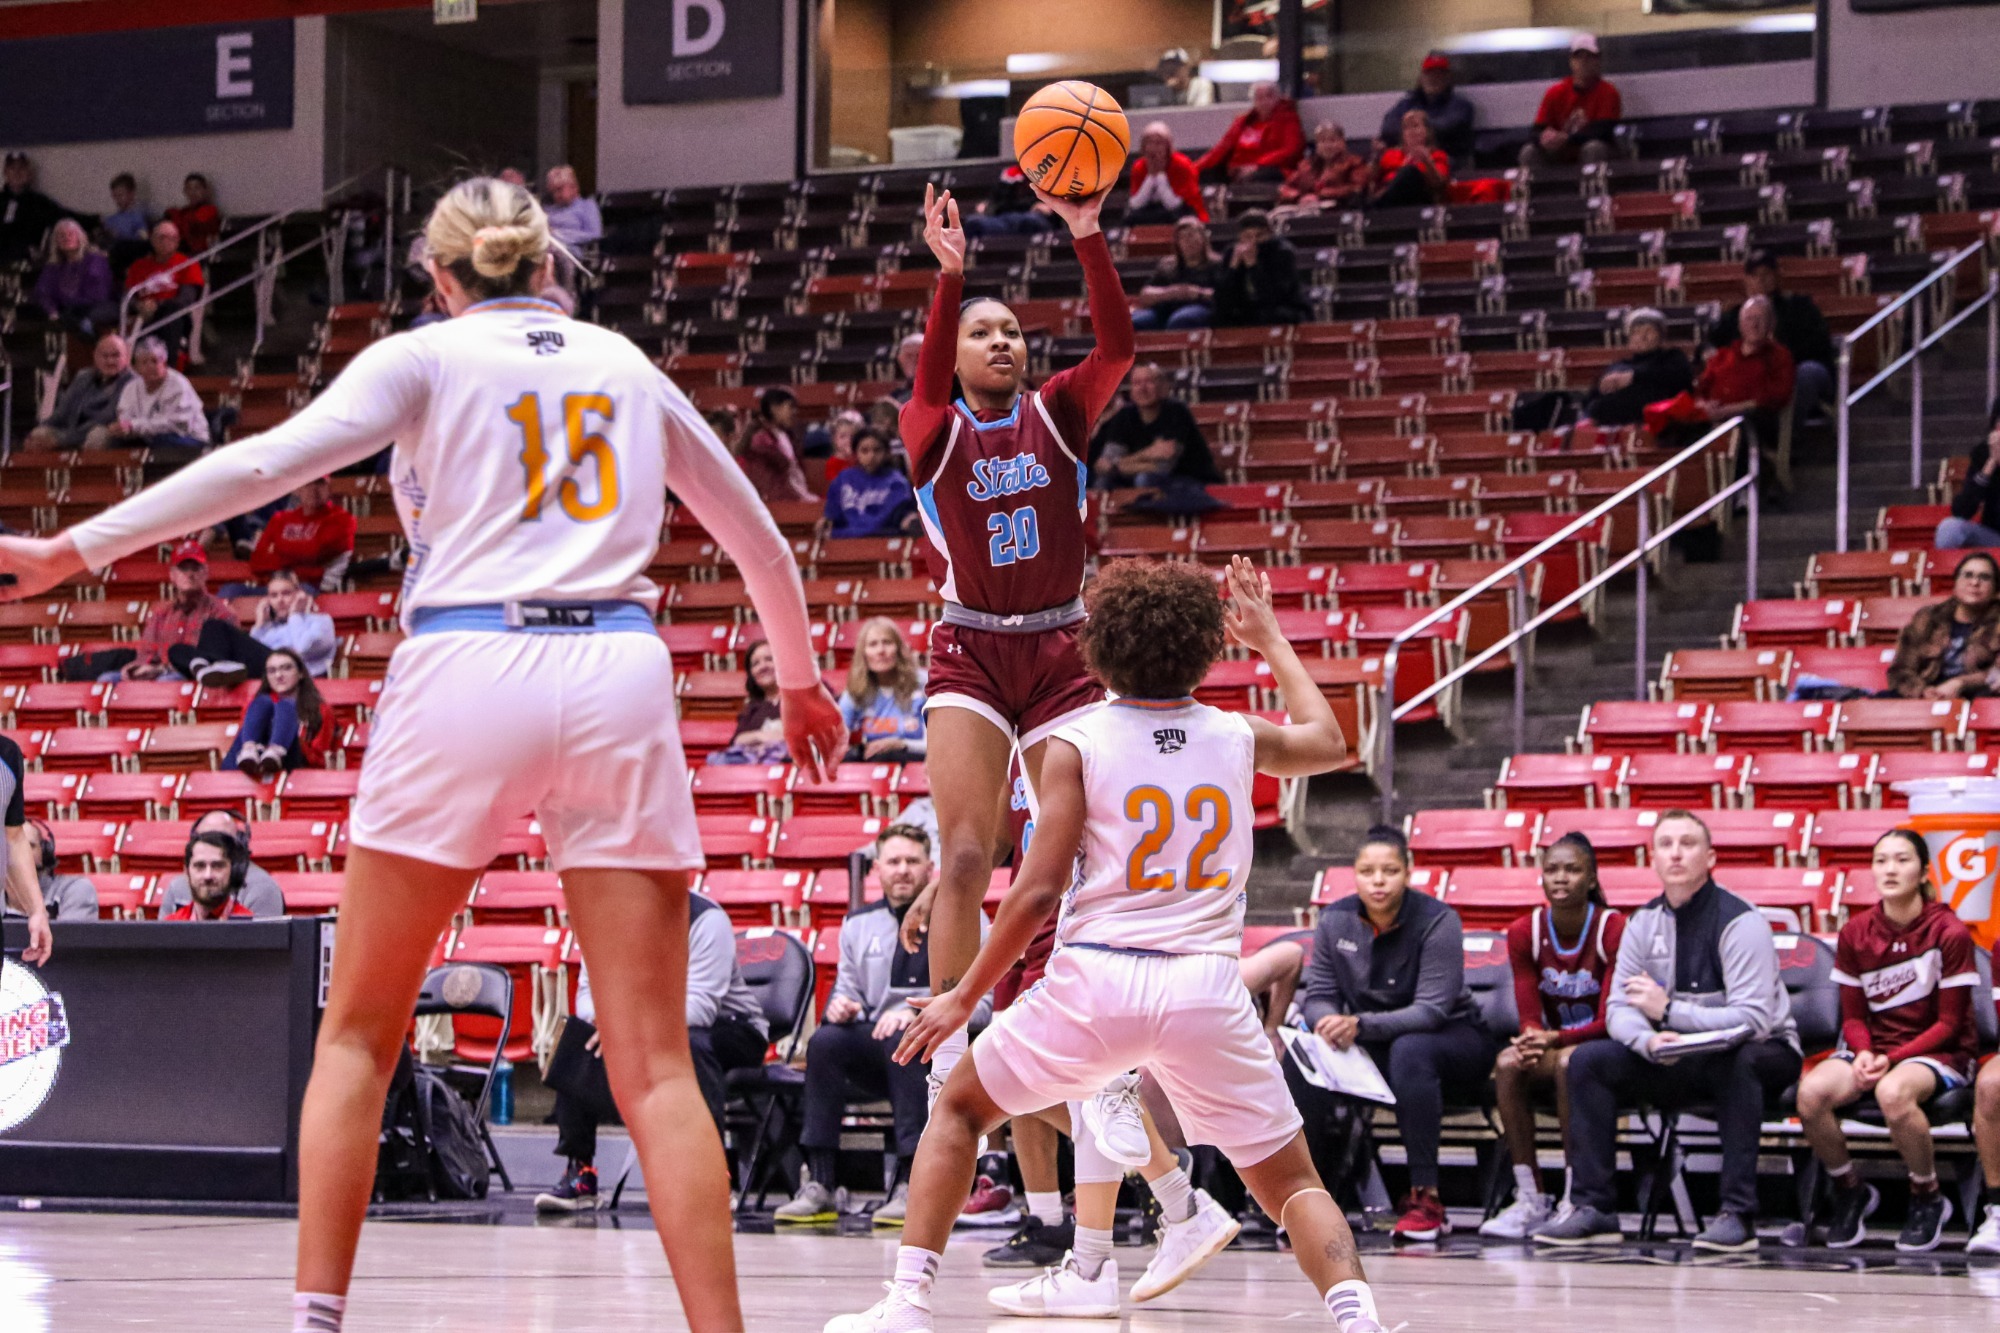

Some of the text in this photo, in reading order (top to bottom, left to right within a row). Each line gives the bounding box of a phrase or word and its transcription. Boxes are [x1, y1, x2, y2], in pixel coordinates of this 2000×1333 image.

[672, 0, 726, 57] D
[216, 32, 253, 98] E
[666, 61, 732, 81] SECTION
[205, 102, 266, 121] SECTION
[526, 330, 566, 347] SUU
[504, 391, 622, 525] 15
[967, 452, 1051, 501] State
[987, 505, 1041, 567] 20
[1153, 728, 1187, 745] SUU
[1123, 783, 1233, 893] 22
[1945, 837, 1987, 882] G
